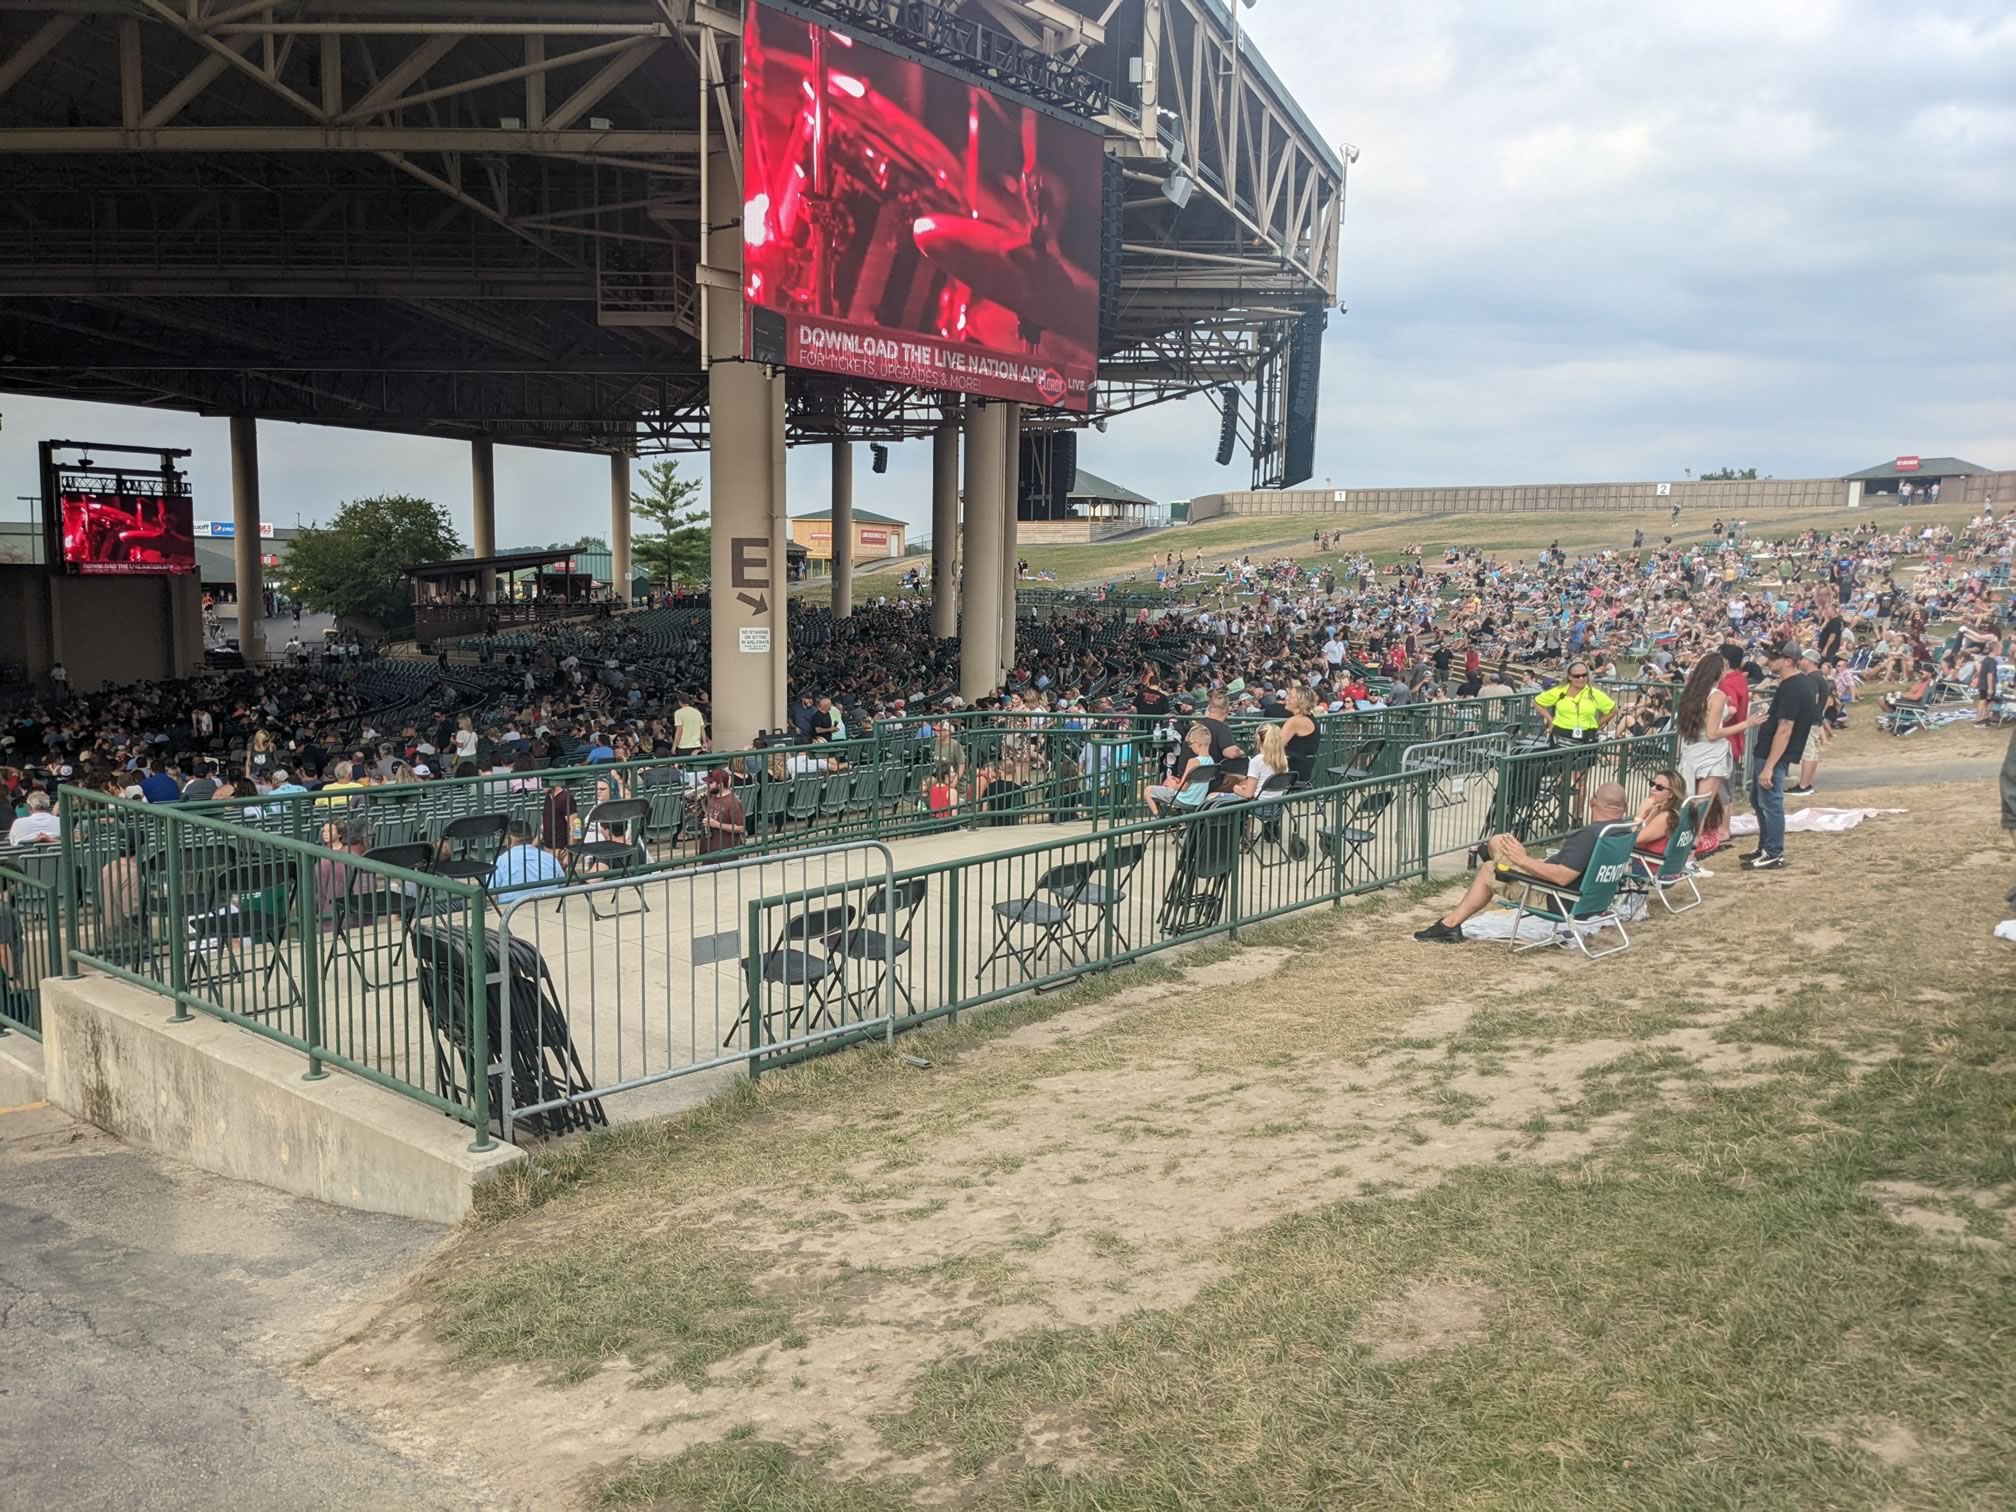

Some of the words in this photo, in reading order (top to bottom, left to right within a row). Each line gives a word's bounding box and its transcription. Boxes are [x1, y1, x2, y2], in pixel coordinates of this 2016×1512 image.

[799, 324, 899, 359] DOWNLOAD
[901, 342, 932, 366] THE
[934, 348, 966, 370] LIVE
[968, 354, 1018, 378] NATION
[799, 349, 825, 367] FOR
[829, 353, 878, 377] TICKETS,
[881, 362, 938, 385] UPGRADES
[940, 372, 948, 386] &
[1067, 376, 1086, 391] LIVE
[1660, 484, 1667, 494] 2
[732, 538, 769, 588] E
